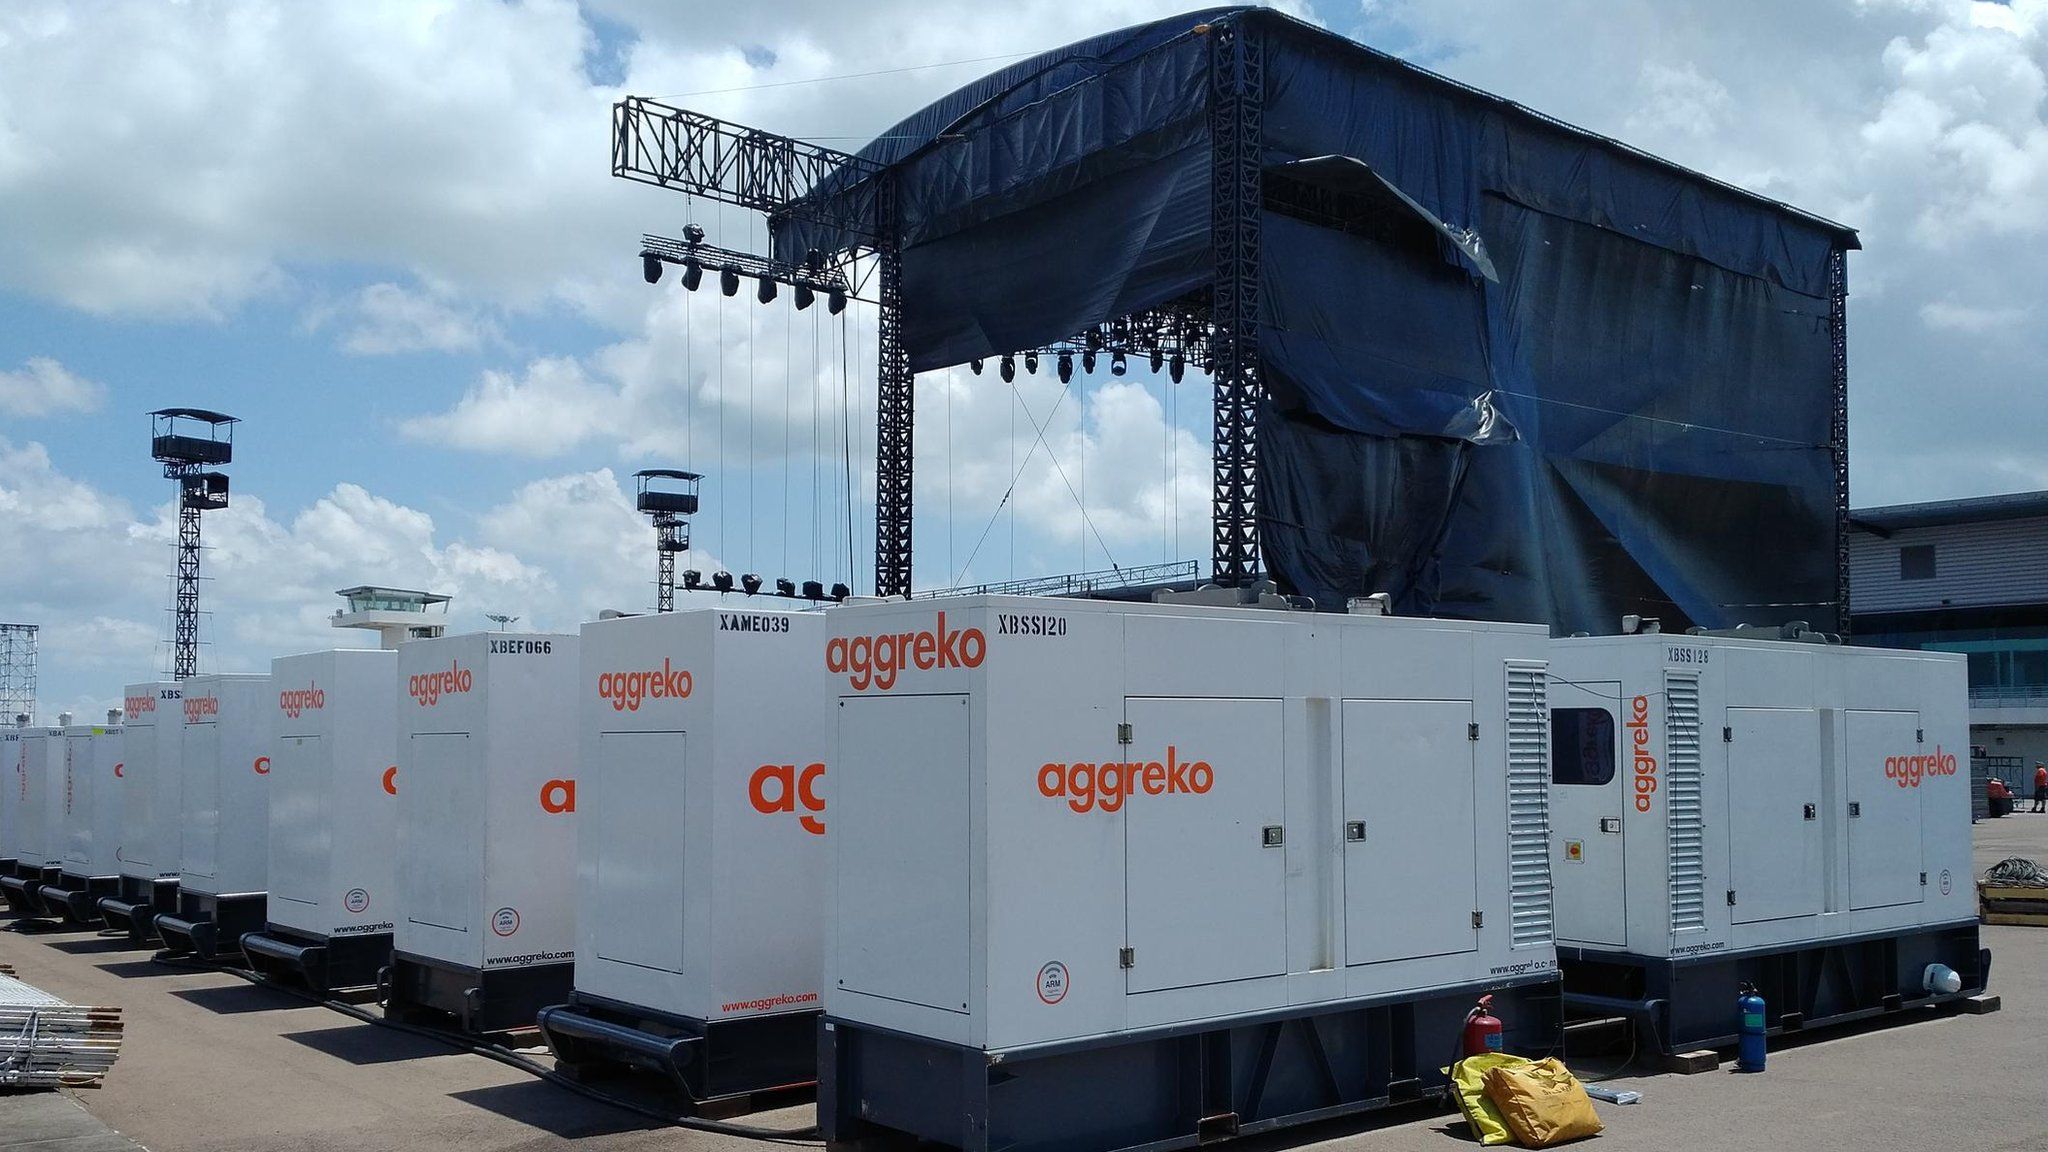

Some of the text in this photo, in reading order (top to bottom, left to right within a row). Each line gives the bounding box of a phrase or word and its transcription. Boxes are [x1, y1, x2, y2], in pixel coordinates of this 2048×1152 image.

[720, 614, 789, 633] XAME039
[999, 614, 1067, 636] XBSS120
[490, 640, 552, 655] XBEF066
[826, 611, 986, 691] aggreko
[1668, 647, 1709, 664] XBSS128
[161, 690, 183, 699] XBS
[409, 660, 472, 706] aggreko
[598, 657, 692, 711] aggreko
[125, 688, 156, 719] aggreko
[184, 689, 218, 722] aggreko
[280, 681, 325, 718] aggreko
[1626, 696, 1657, 812] aggreko
[1885, 744, 1957, 788] aggreko
[1037, 745, 1214, 814] aggreko
[486, 950, 575, 965] www.aggreko.com
[722, 993, 818, 1011] www.aggreko.com
